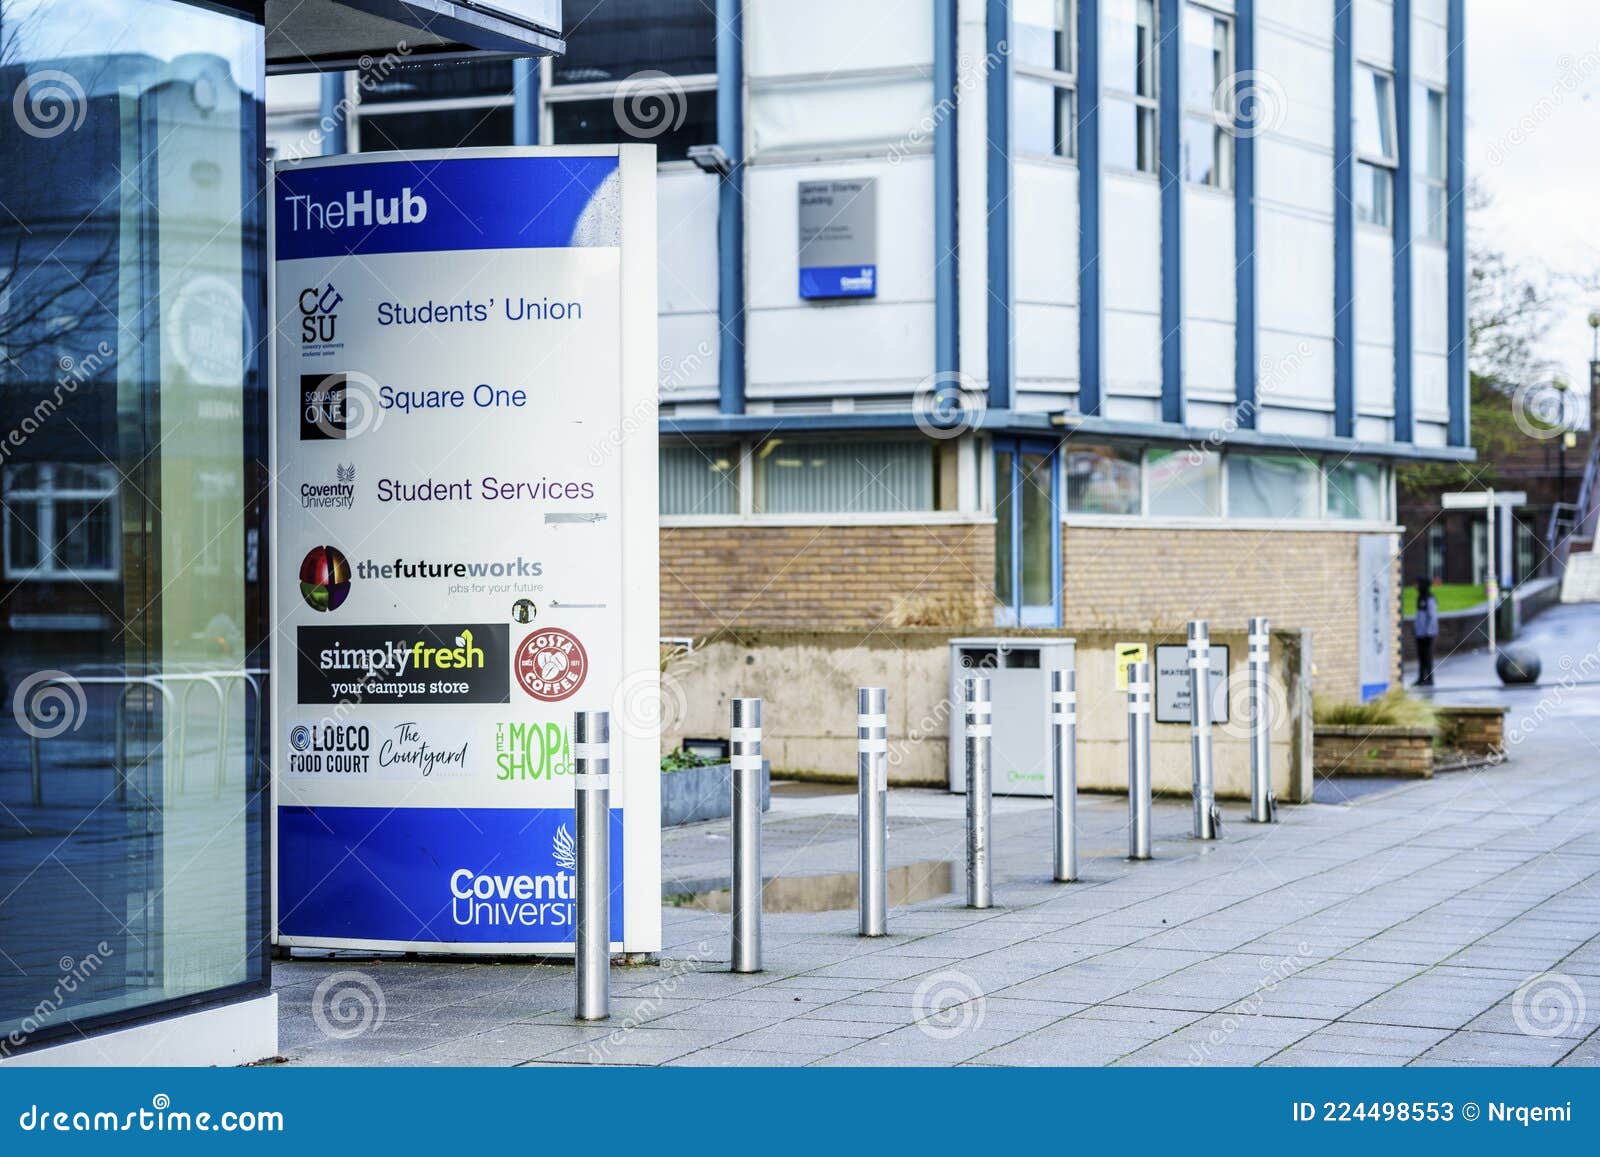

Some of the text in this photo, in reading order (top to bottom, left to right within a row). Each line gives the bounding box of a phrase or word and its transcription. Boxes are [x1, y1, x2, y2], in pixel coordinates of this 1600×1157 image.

[377, 297, 582, 326] Students' Union
[304, 390, 342, 402] SQUARE
[378, 384, 527, 415] Square One
[305, 404, 342, 424] ONE
[301, 482, 354, 498] Coventry
[377, 476, 595, 502] Student Services
[301, 494, 354, 510] University
[357, 557, 543, 579] thefutureworks
[448, 582, 544, 595] jobs for your future
[528, 634, 573, 654] COSTA
[331, 680, 470, 698] your campus store
[525, 671, 578, 695] COFFEE
[394, 722, 421, 744] The
[290, 755, 370, 772] FOOD COURT
[379, 739, 468, 777] Courtyard
[450, 868, 575, 900] Covent
[452, 897, 575, 926] Universi
